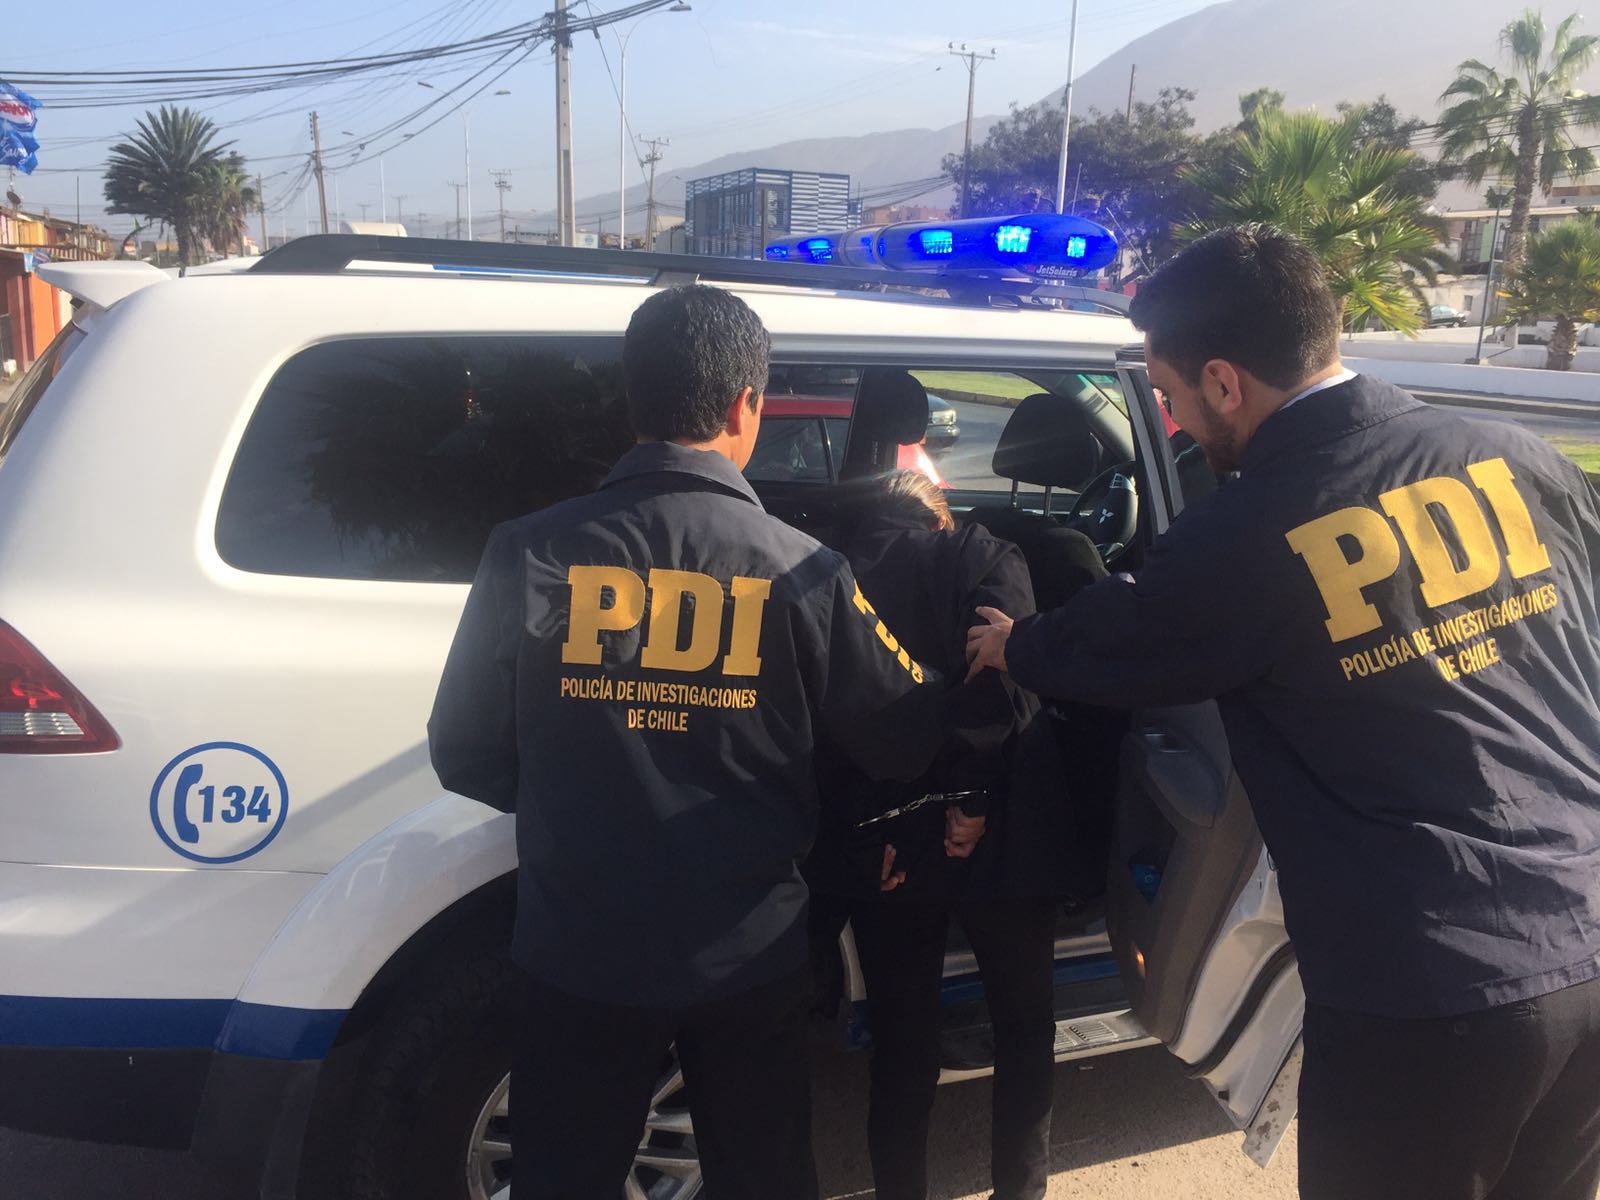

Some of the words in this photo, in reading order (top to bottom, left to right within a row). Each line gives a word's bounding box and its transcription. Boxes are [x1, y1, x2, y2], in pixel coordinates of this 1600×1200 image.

[1284, 457, 1551, 643] PDI
[561, 565, 772, 676] PDI
[1339, 635, 1417, 681] POLICÍA
[1412, 627, 1436, 656] DE
[1433, 583, 1558, 648] INVESTIGACIONES
[1436, 655, 1460, 682] DE
[1458, 638, 1500, 674] CHILE
[560, 675, 614, 699] POLICÍA
[616, 680, 636, 701] DE
[637, 681, 757, 709] INVESTIGACIONES
[627, 708, 646, 729] DE
[647, 709, 689, 732] CHILE
[198, 785, 271, 823] 134
